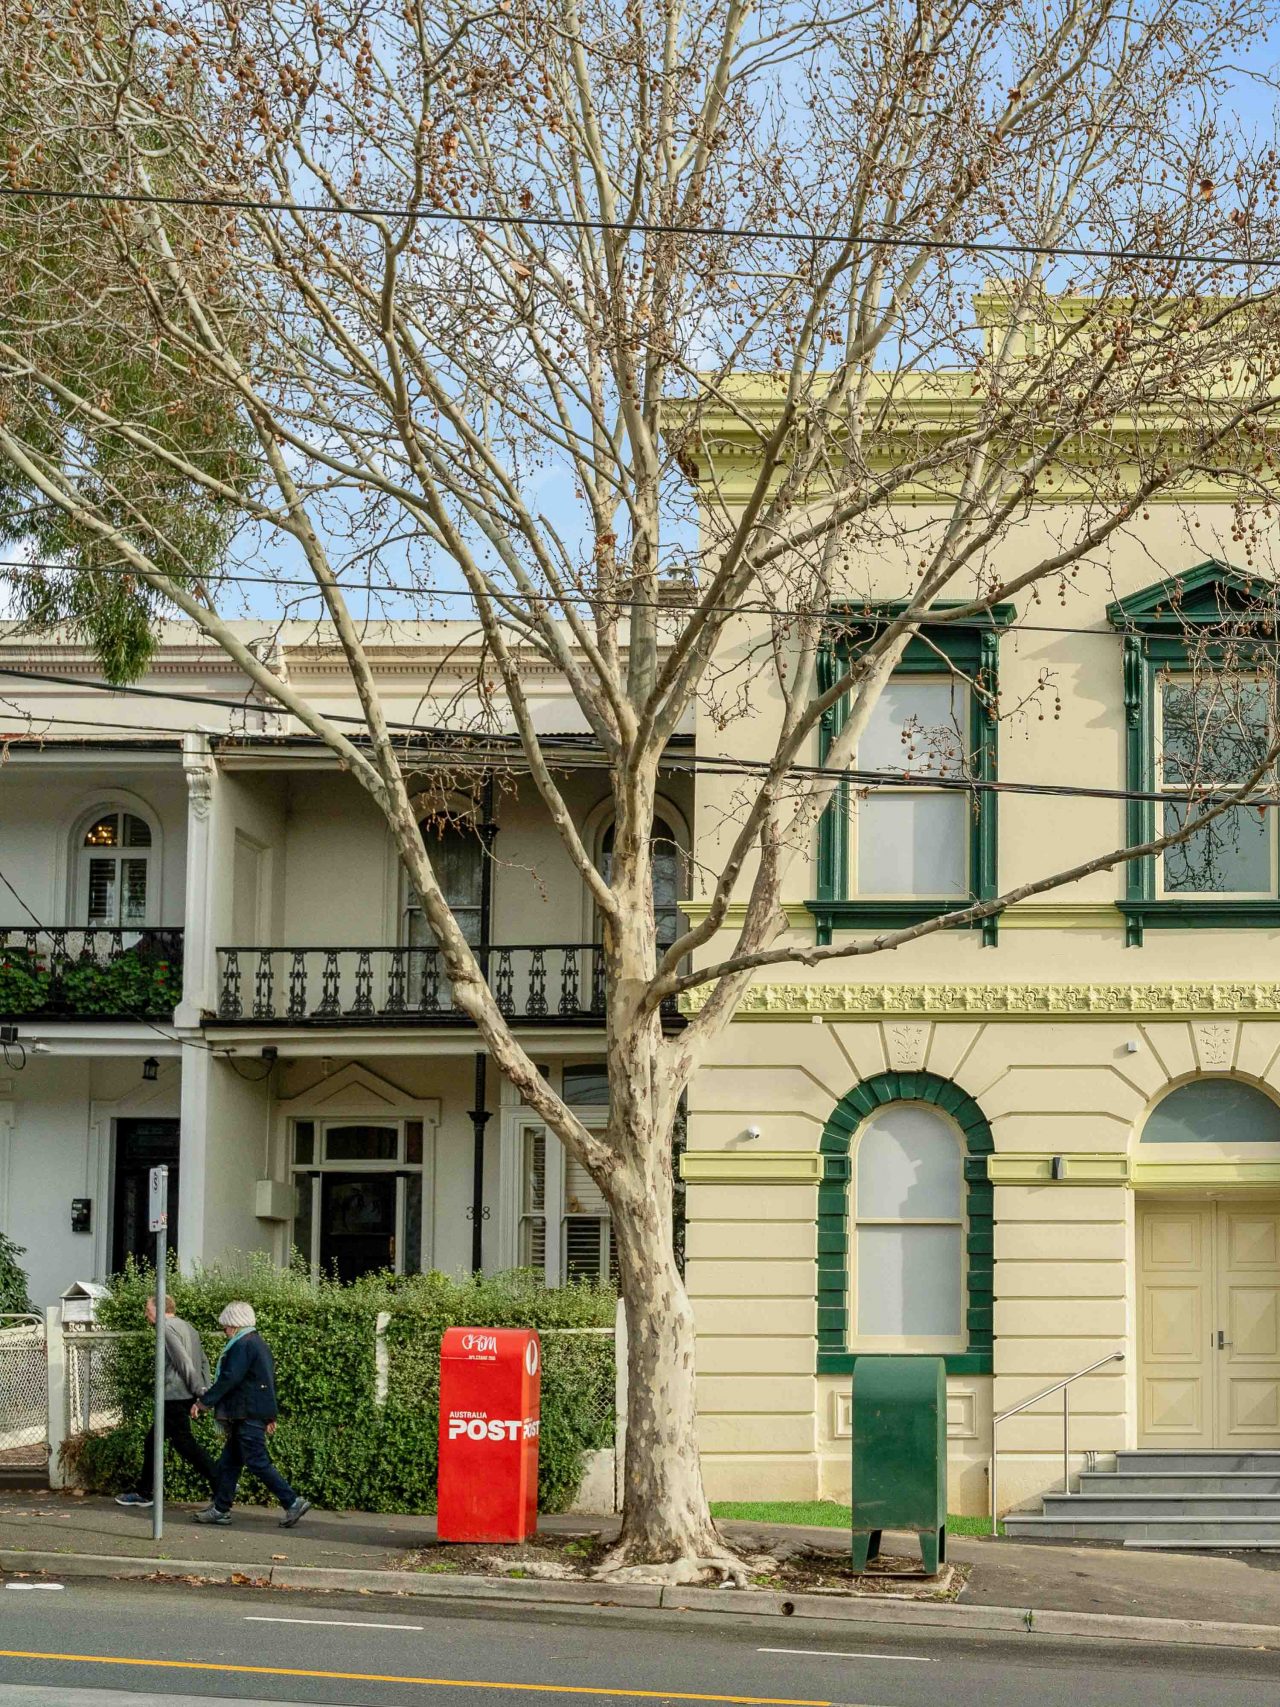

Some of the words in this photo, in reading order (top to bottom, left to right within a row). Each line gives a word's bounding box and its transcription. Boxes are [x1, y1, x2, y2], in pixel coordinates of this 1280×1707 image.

[449, 1411, 488, 1419] AUSTRALIA
[448, 1419, 523, 1441] POST
[523, 1420, 540, 1440] POST
